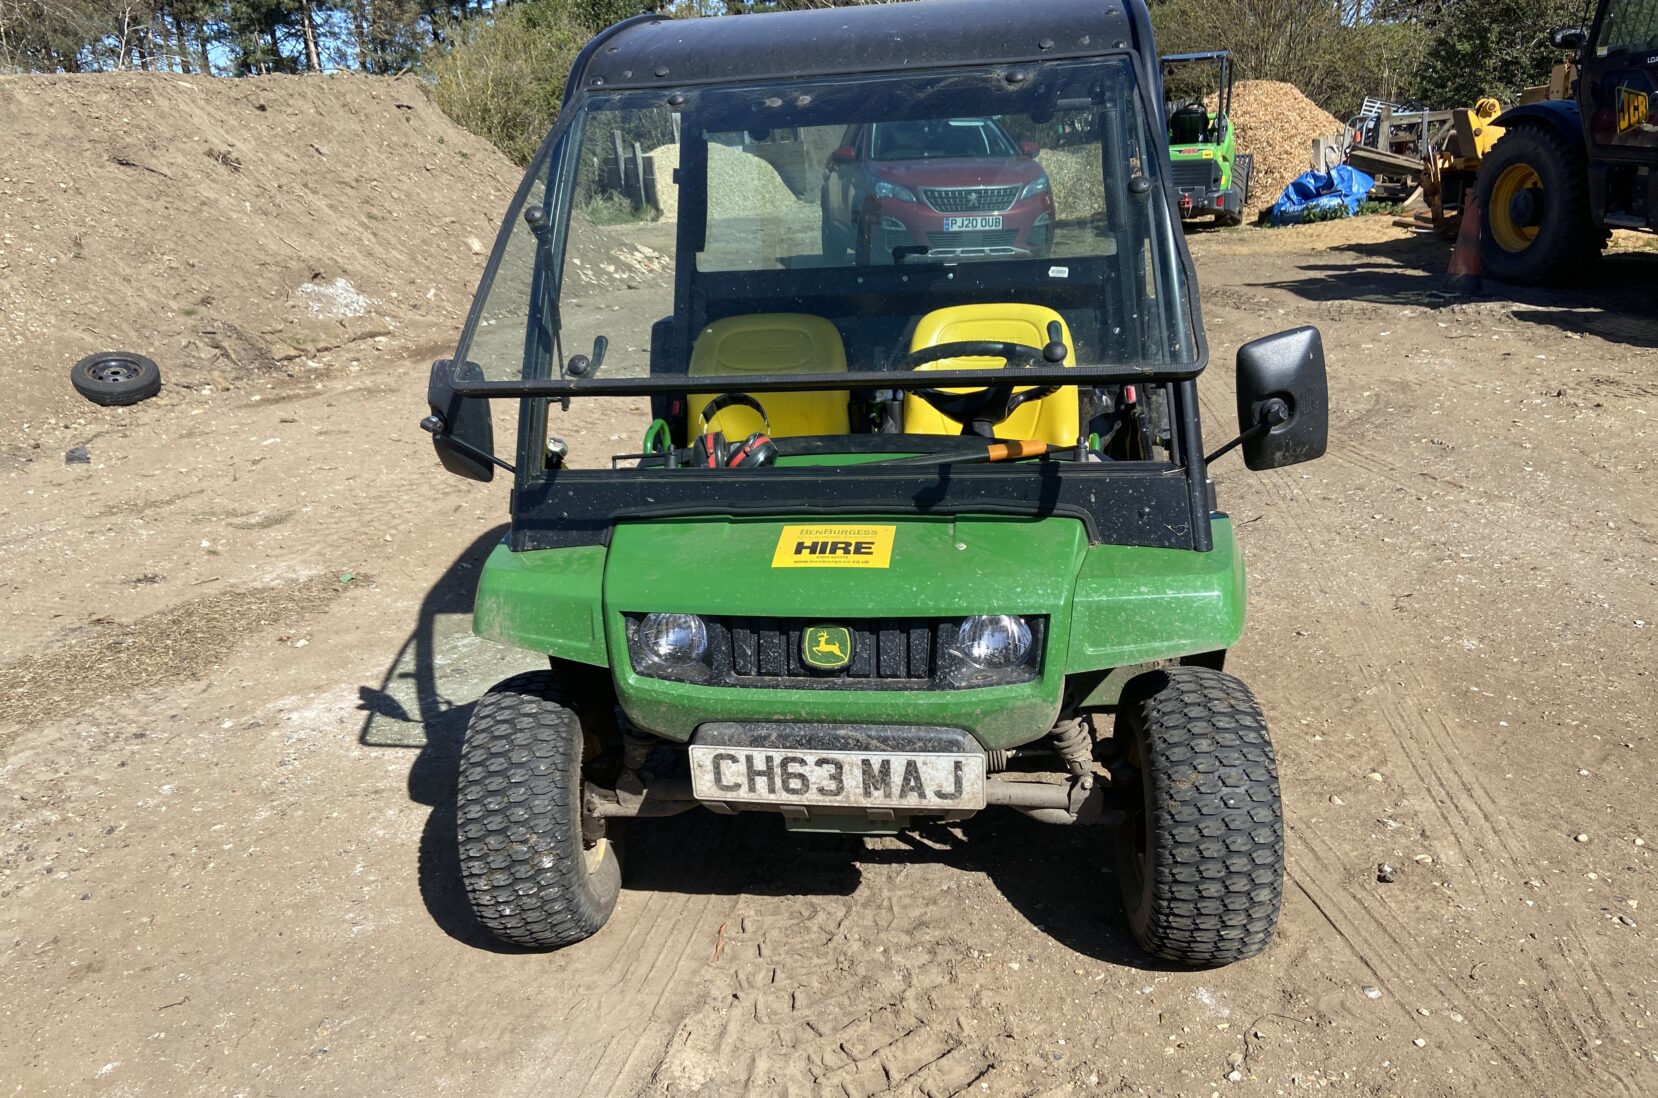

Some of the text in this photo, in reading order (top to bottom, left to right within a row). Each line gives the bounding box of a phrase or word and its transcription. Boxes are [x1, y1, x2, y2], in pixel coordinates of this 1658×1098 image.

[1619, 92, 1646, 129] JCB
[951, 218, 1001, 228] PJ20 OUB
[794, 541, 875, 556] HIRE
[711, 753, 963, 800] CH63 MAJ
